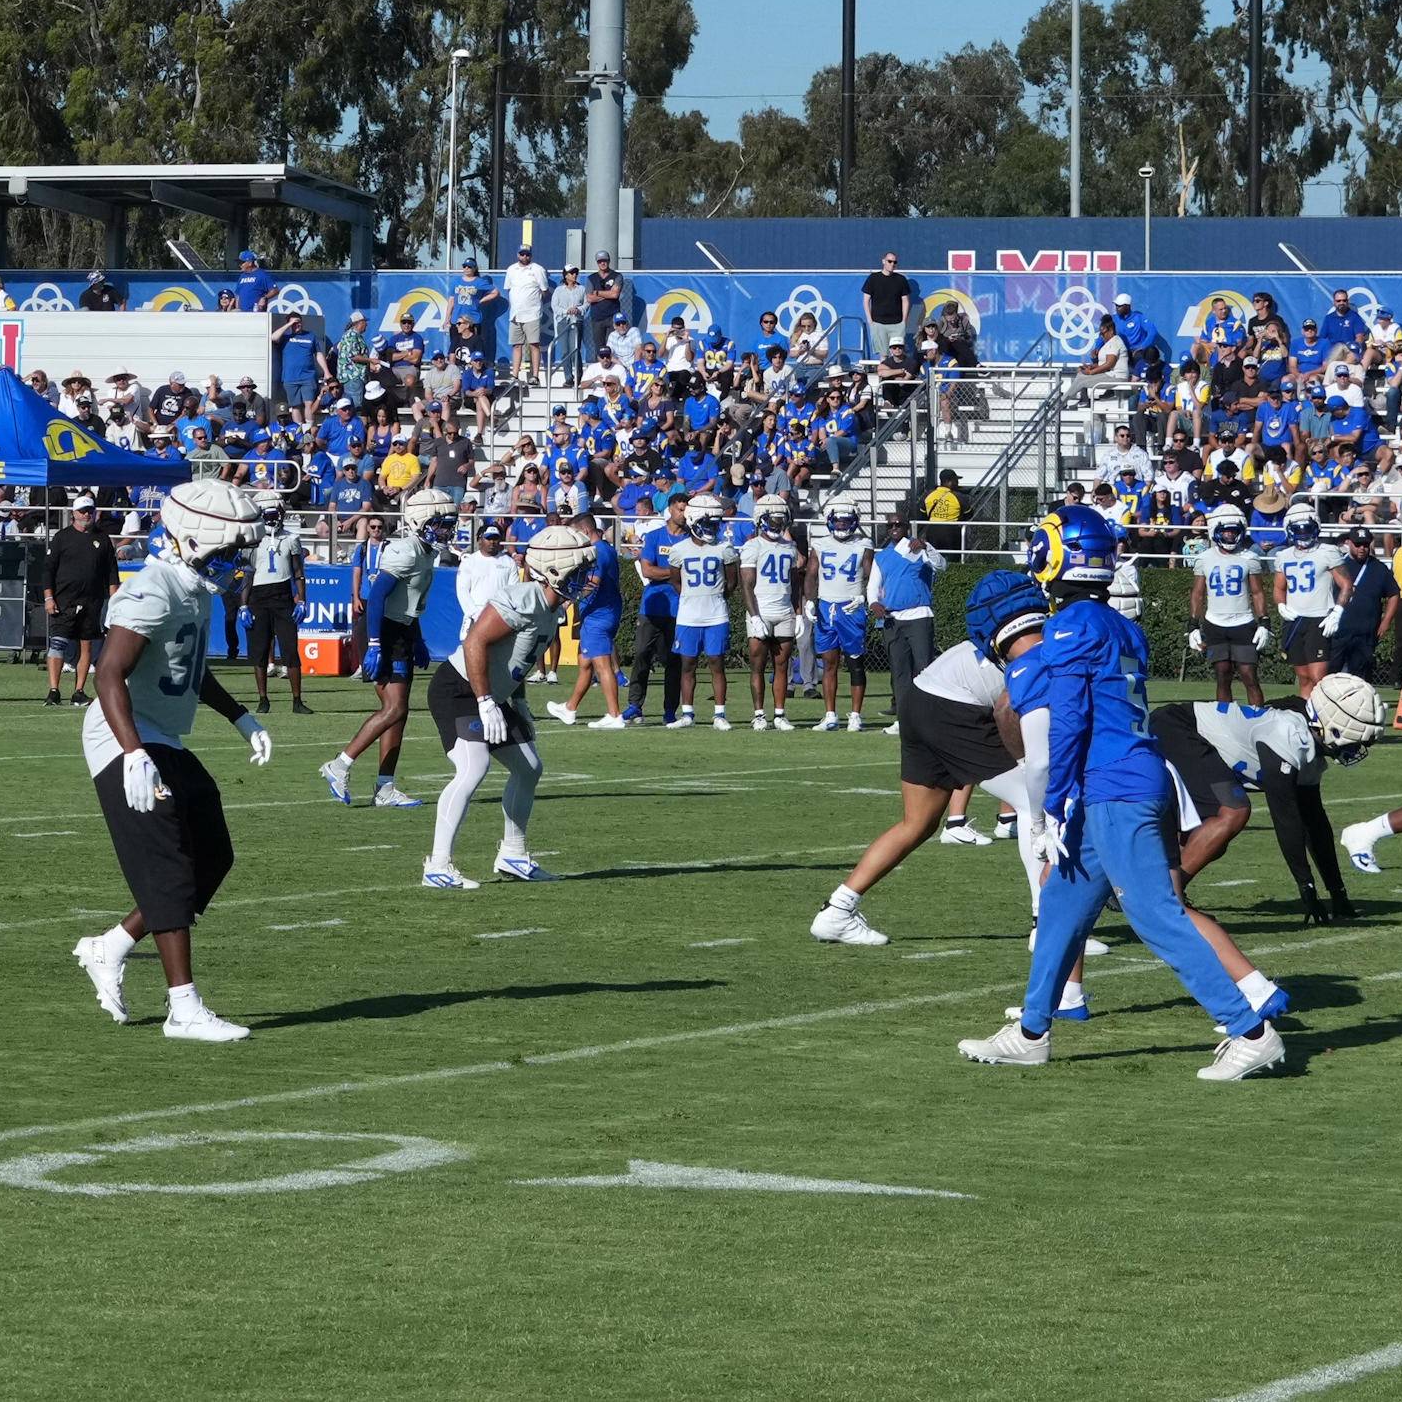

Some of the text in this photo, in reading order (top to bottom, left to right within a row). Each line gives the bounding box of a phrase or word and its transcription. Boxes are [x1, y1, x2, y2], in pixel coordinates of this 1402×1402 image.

[267, 547, 278, 573] 1
[684, 556, 720, 588] 58
[760, 553, 792, 584] 40
[820, 552, 858, 583] 54
[1209, 564, 1244, 596] 48
[1283, 560, 1316, 594] 53
[305, 643, 319, 660] G
